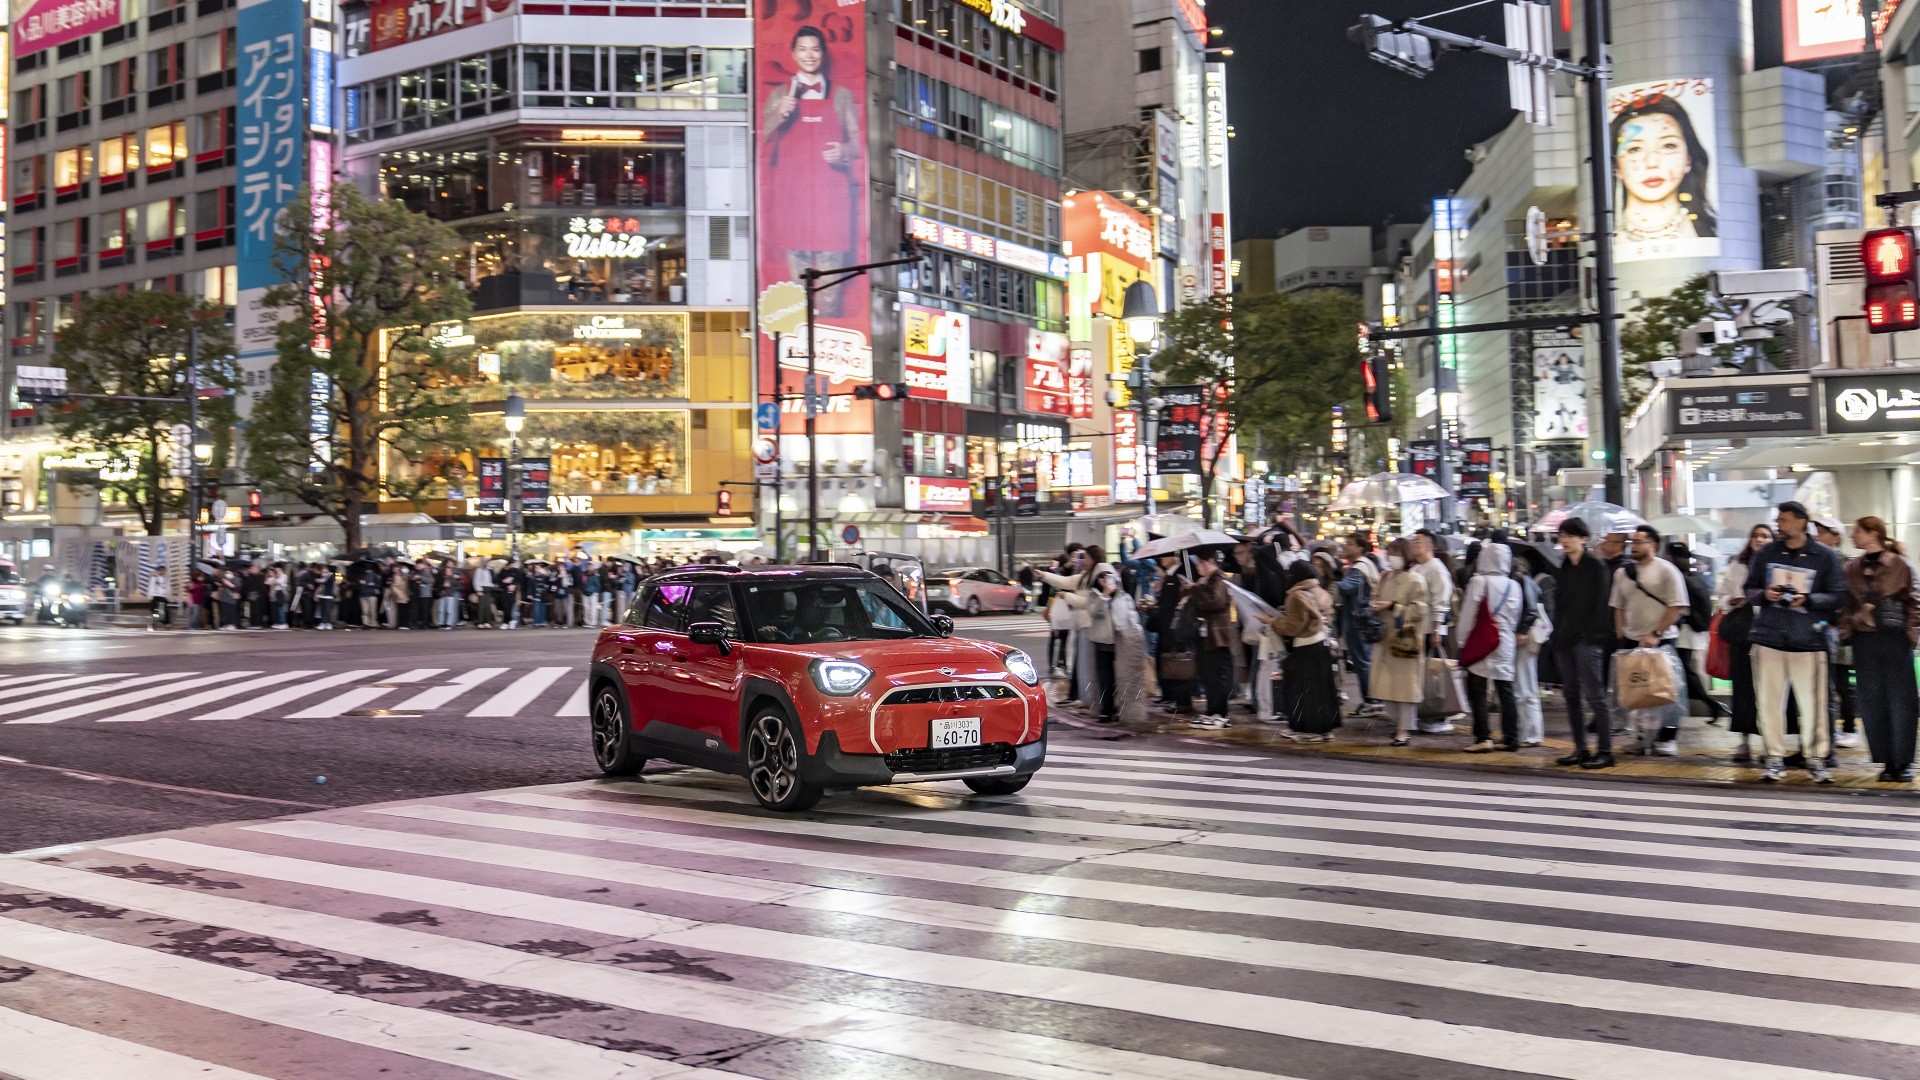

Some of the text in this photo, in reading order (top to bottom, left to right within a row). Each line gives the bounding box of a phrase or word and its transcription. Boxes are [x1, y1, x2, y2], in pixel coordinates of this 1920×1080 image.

[346, 18, 371, 45] 7F
[242, 39, 271, 242] アイシティ
[943, 730, 978, 745] 60-70
